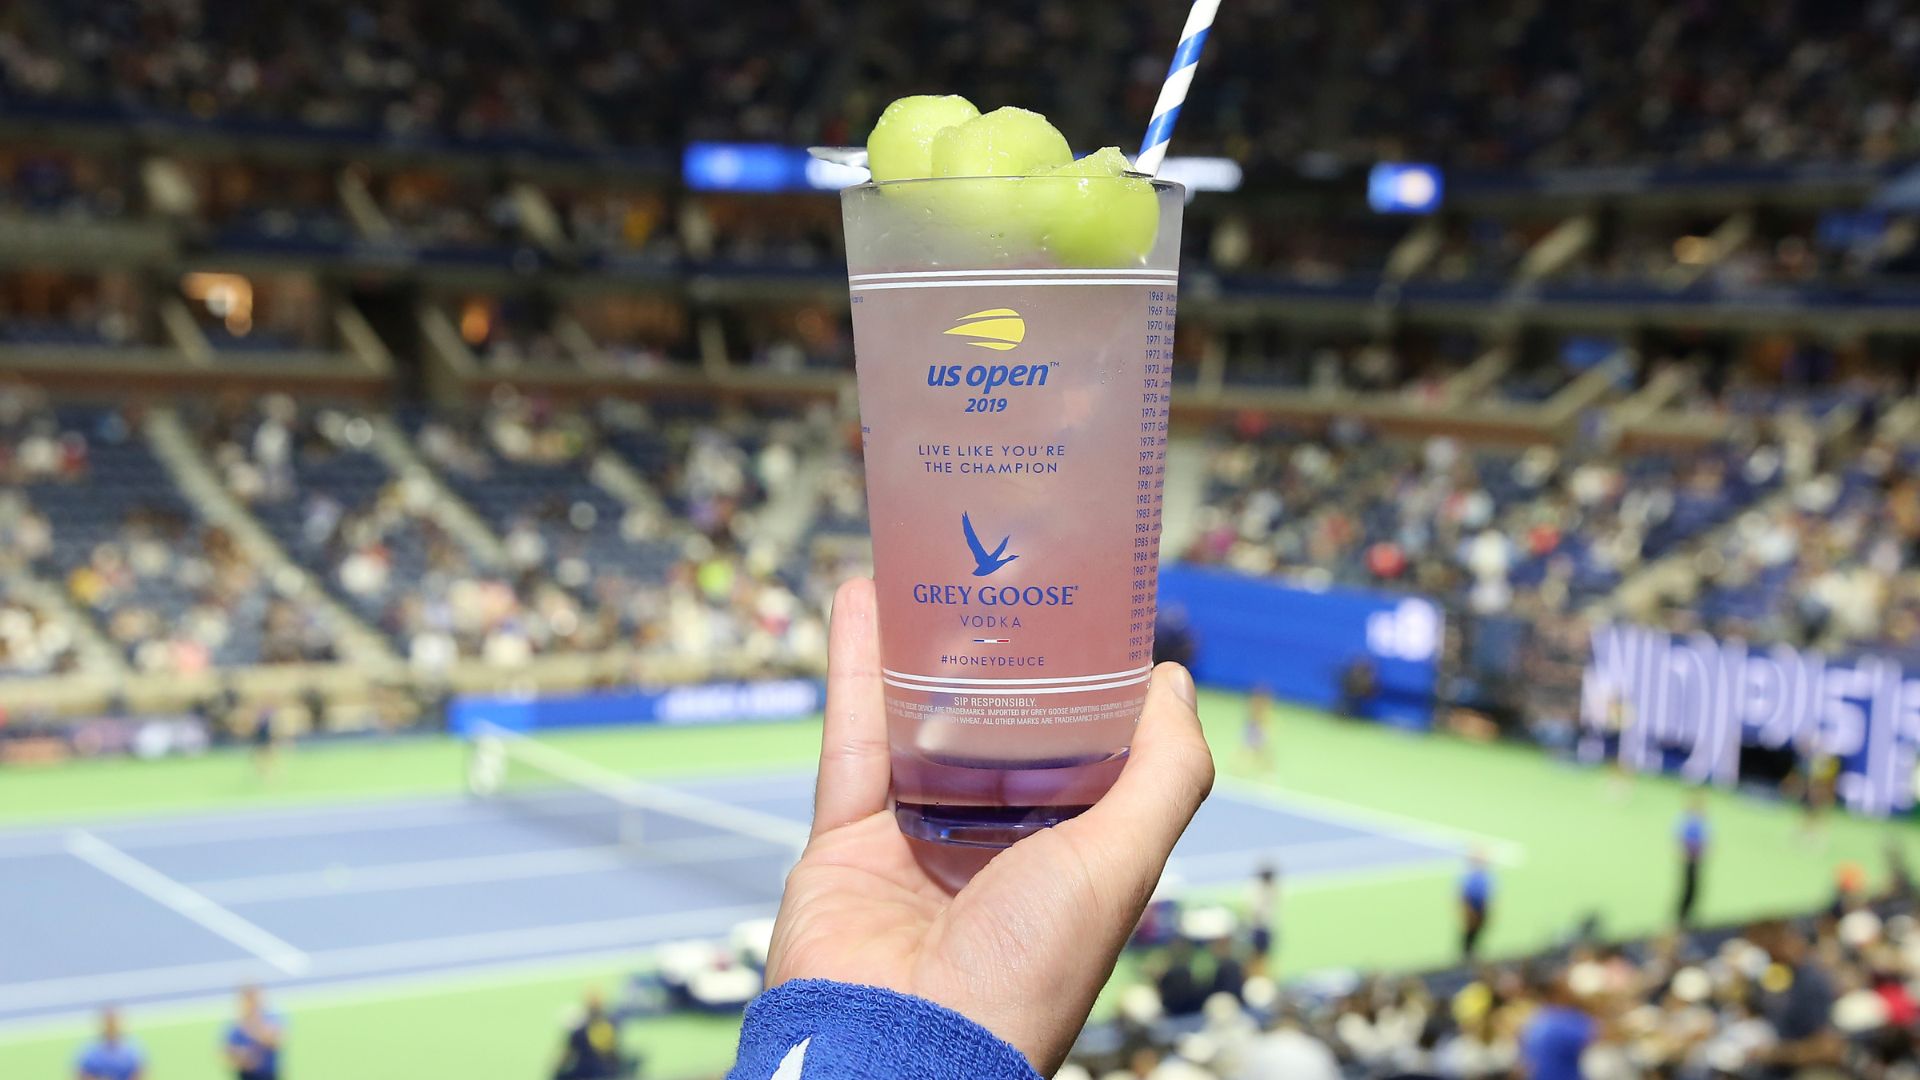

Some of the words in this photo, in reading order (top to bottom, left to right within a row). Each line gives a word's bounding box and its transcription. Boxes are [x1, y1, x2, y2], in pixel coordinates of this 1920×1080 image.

[1149, 291, 1163, 301] 1968
[1148, 306, 1162, 315] 1969
[1147, 321, 1162, 330] 1970
[1146, 335, 1160, 345] 1971
[1145, 350, 1160, 359] 1972
[1145, 364, 1159, 374] 1973
[927, 365, 962, 387] us
[1144, 379, 1158, 388] 1974
[1143, 393, 1158, 403] 1975
[965, 398, 1008, 413] 2019
[1142, 408, 1156, 418] 1976
[1141, 422, 1156, 432] 1977
[1140, 437, 1154, 446] 1978
[918, 445, 951, 456] LIVE
[958, 445, 994, 457] LIKE
[1002, 445, 1065, 457] YOU'RE
[1139, 451, 1153, 461] 1979
[925, 462, 952, 473] THE
[960, 462, 1057, 474] CHAMPION
[1138, 465, 1153, 475] 1980
[913, 584, 972, 605] GREY
[960, 615, 1022, 628] VODKA
[941, 654, 1045, 666] #HONEYDEUCE
[954, 696, 969, 706] SIP
[971, 697, 1037, 707] RESPONSIBLY.
[987, 708, 1019, 716] IMPORTED
[1030, 708, 1047, 716] GREY
[1048, 707, 1069, 715] GOOSE
[1069, 705, 1100, 714] IMPORTING
[982, 717, 994, 725] ALL
[995, 717, 1016, 725] OTHER
[1016, 717, 1040, 725] MARKS
[1041, 717, 1053, 725] ARE
